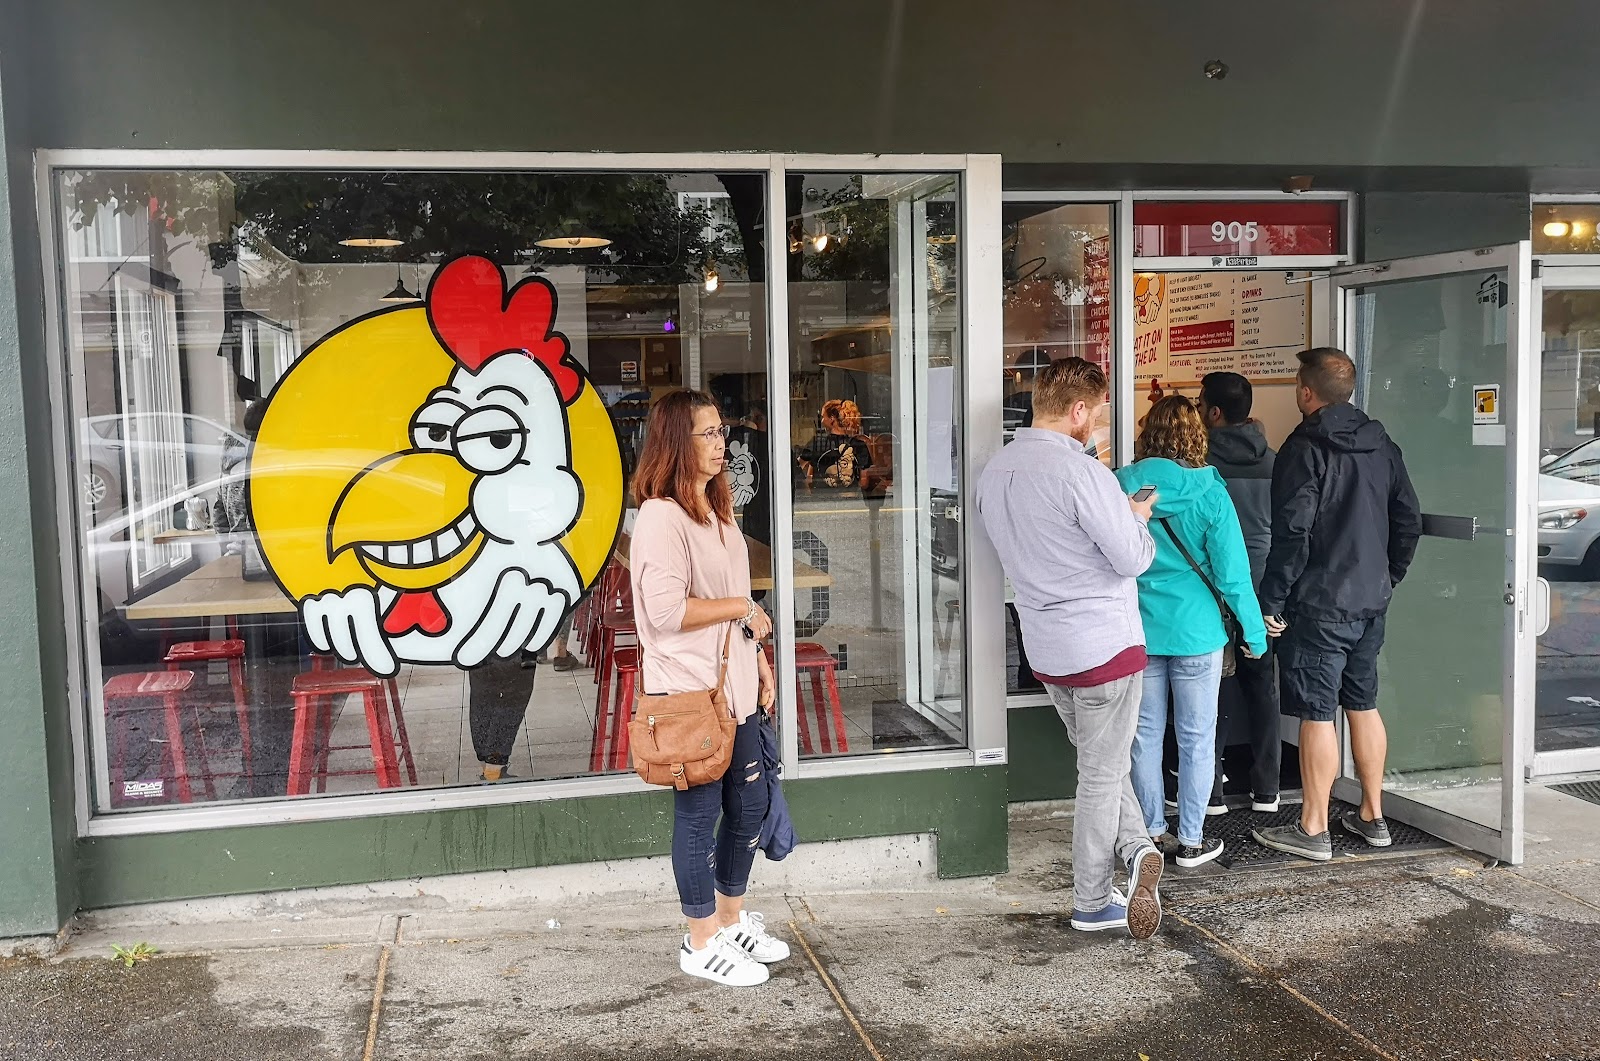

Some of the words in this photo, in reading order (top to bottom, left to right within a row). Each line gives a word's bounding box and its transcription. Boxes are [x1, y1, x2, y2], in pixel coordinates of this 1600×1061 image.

[1211, 221, 1258, 242] 905
[1242, 288, 1262, 299] DRINKS
[1091, 320, 1101, 330] NOT
[1134, 335, 1143, 352] AT
[1143, 332, 1151, 348] IT
[1152, 328, 1162, 345] ON
[1135, 350, 1148, 367] THE
[1149, 347, 1157, 363] DL
[125, 781, 163, 792] MIDAS
